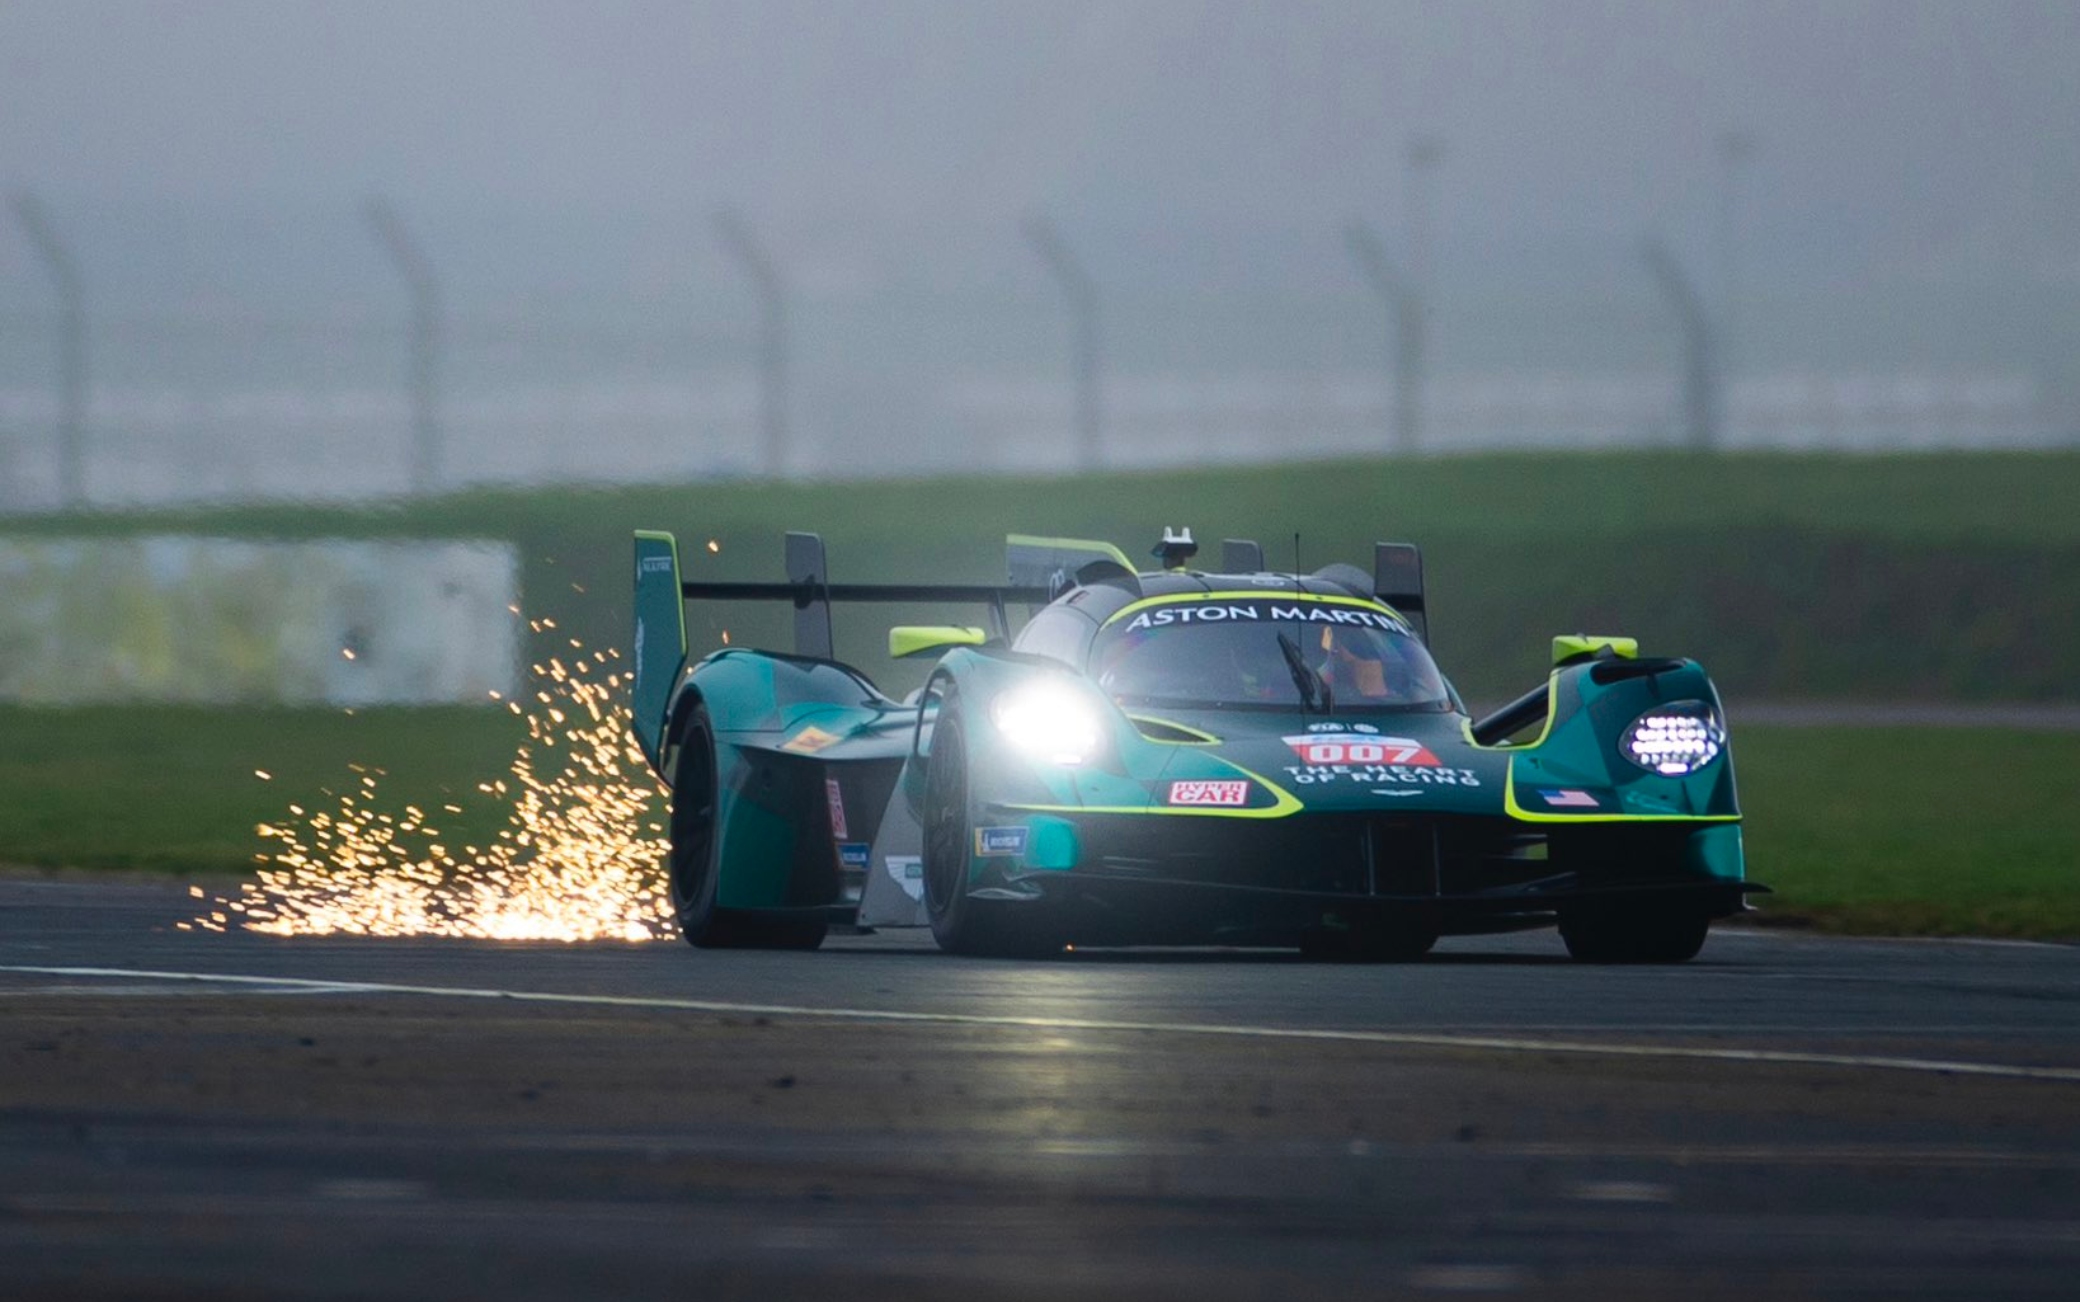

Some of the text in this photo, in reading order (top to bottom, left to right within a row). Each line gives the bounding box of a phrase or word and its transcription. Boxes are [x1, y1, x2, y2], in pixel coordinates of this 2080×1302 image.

[1125, 606, 1410, 637] ASTON MARTIN
[1308, 745, 1421, 762] 007
[1283, 765, 1475, 778] THE HEART
[1176, 782, 1242, 790] HYPER
[1295, 773, 1481, 787] OF RACING
[1174, 790, 1241, 802] CAR
